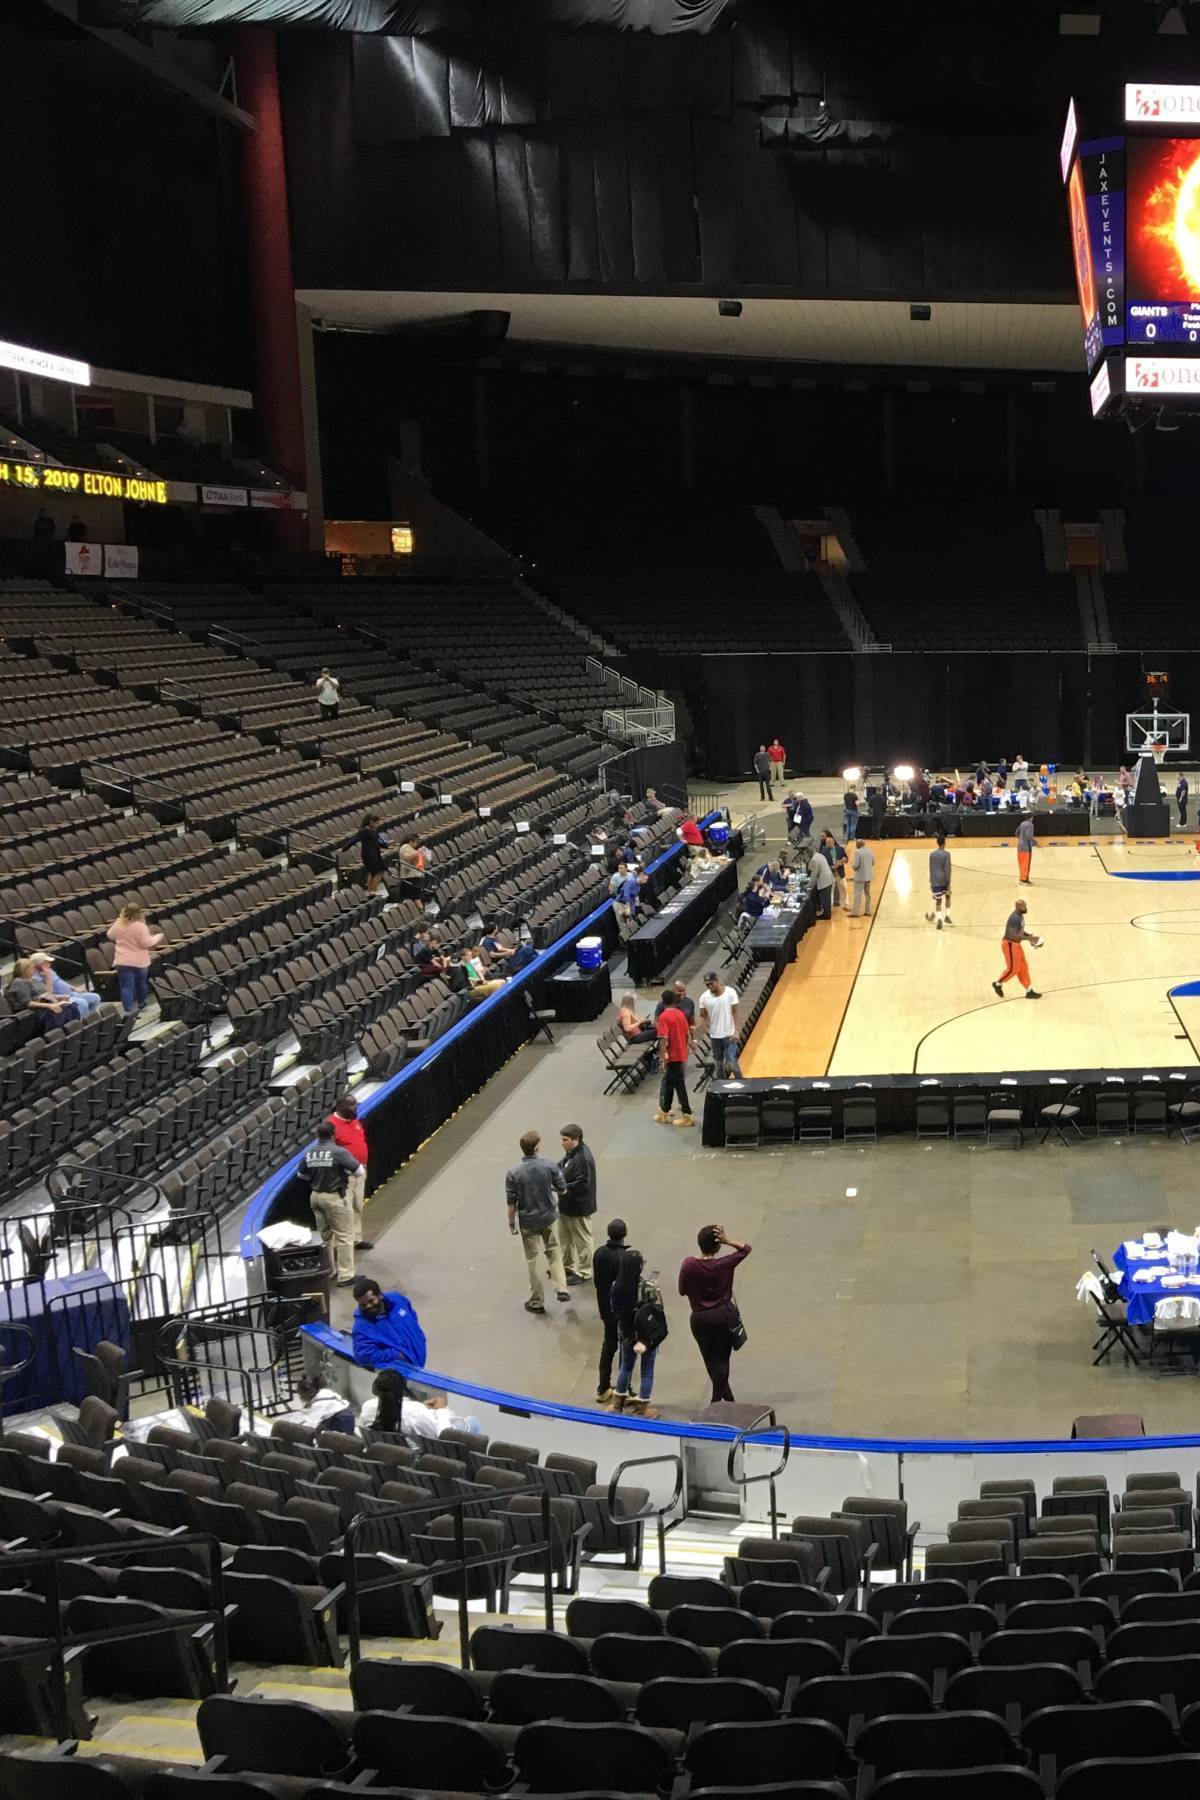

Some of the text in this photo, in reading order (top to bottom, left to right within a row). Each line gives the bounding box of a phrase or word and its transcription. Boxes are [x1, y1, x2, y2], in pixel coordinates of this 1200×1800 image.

[1130, 306, 1168, 317] GIANTS
[1146, 323, 1157, 338] 0
[1189, 330, 1197, 342] 0
[15, 466, 40, 487] 15,
[44, 470, 80, 489] 2019
[84, 473, 122, 498] ELTON
[125, 478, 156, 502] JOHN
